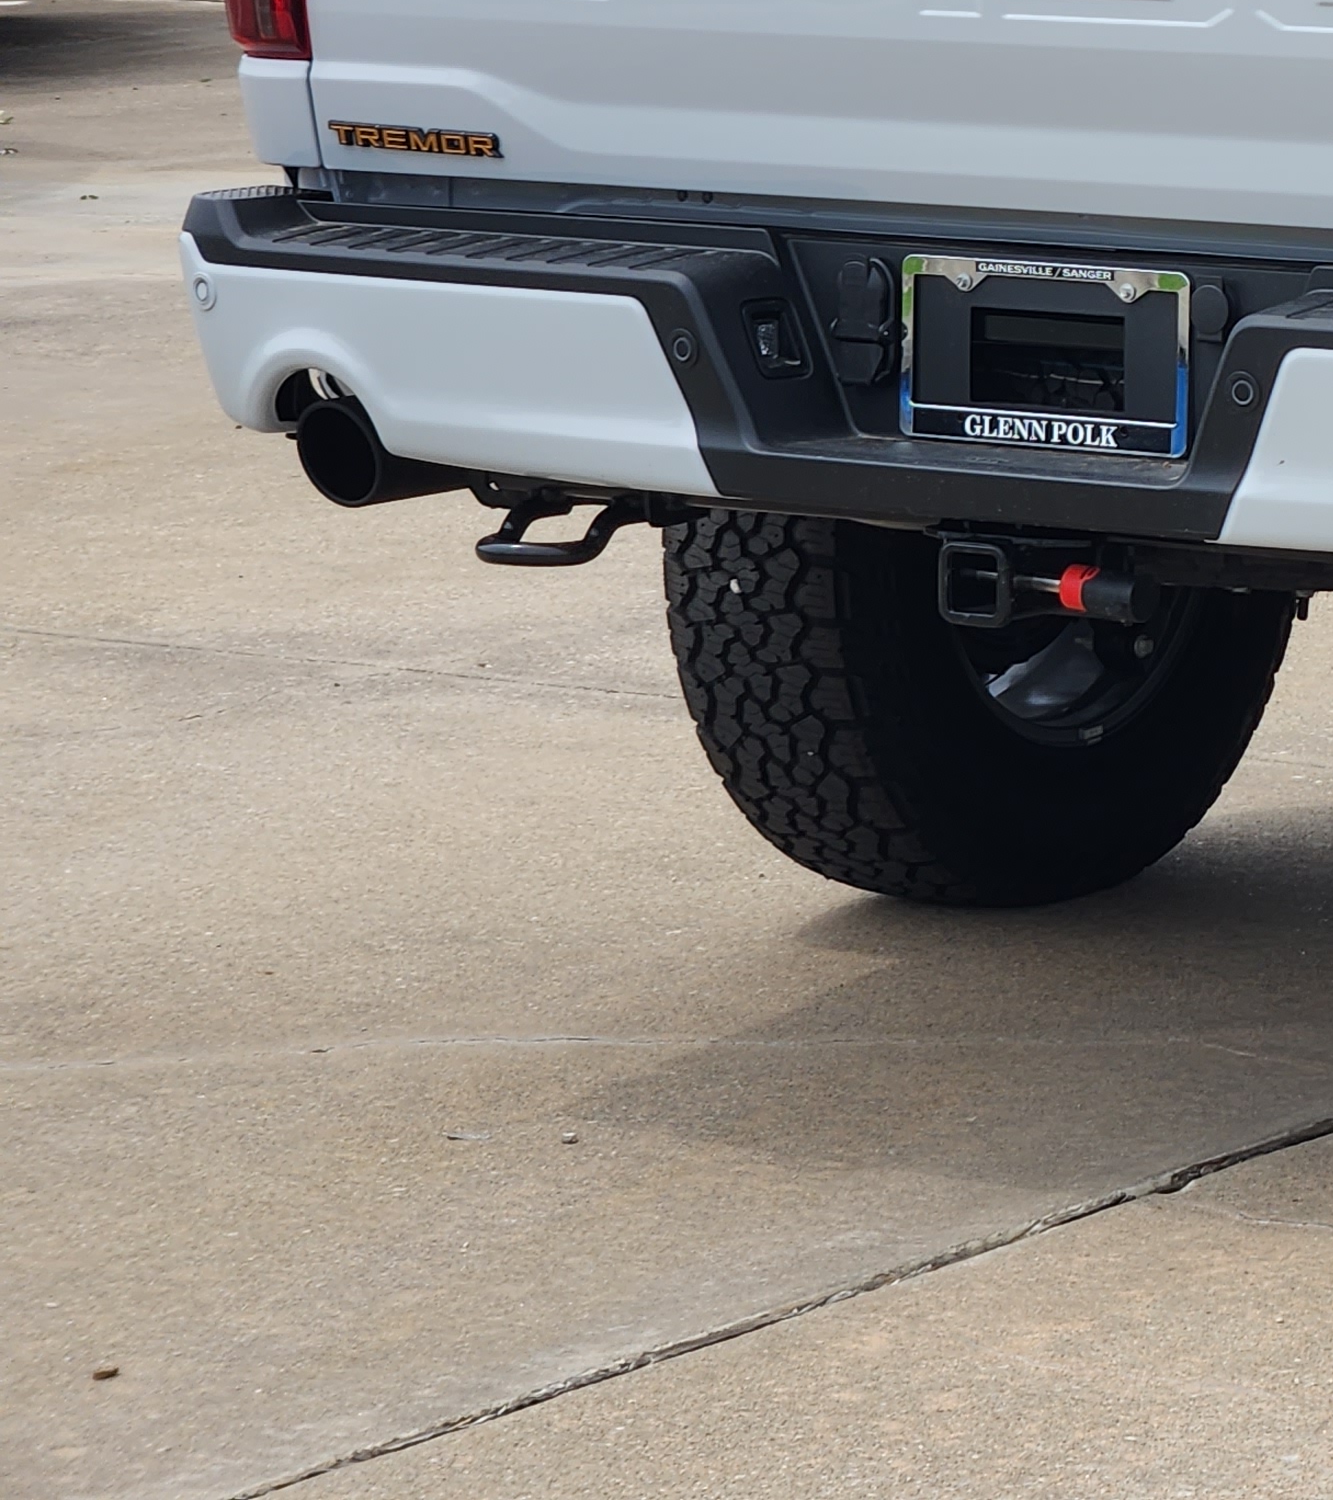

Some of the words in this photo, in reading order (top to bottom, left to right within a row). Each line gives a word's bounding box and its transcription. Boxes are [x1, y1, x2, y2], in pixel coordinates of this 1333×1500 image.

[327, 119, 505, 159] TREMOR
[978, 262, 1053, 277] GAINESVILLE
[1062, 267, 1112, 281] SANGER
[964, 414, 1048, 442] GLENN
[1050, 420, 1118, 448] POLK
